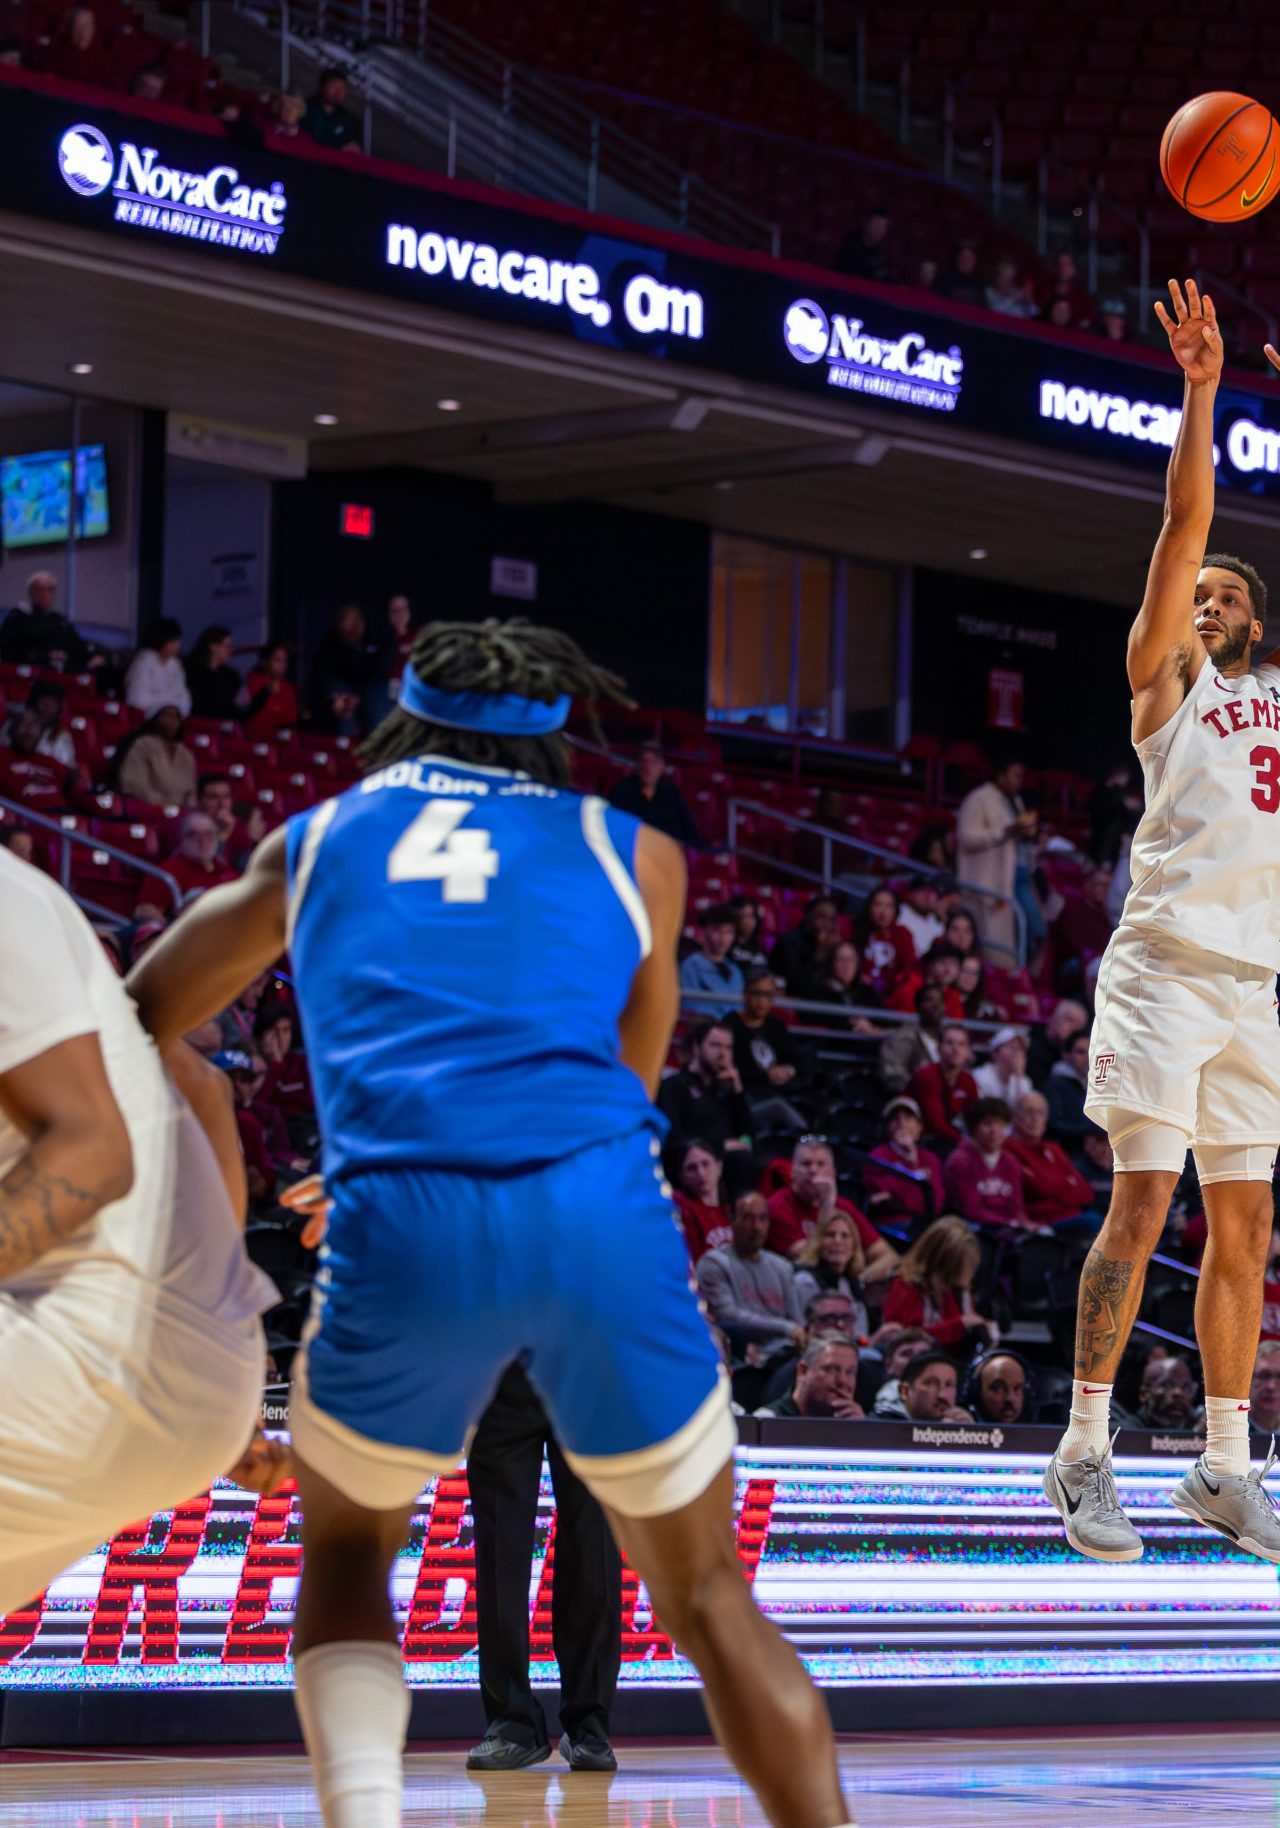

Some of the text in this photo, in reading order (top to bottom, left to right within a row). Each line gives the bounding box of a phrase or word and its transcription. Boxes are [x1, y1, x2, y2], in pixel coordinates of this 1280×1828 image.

[113, 141, 287, 226] NovaCare
[826, 314, 963, 386] NovaCare
[387, 798, 499, 904] 4
[912, 1426, 990, 1447] Independence
